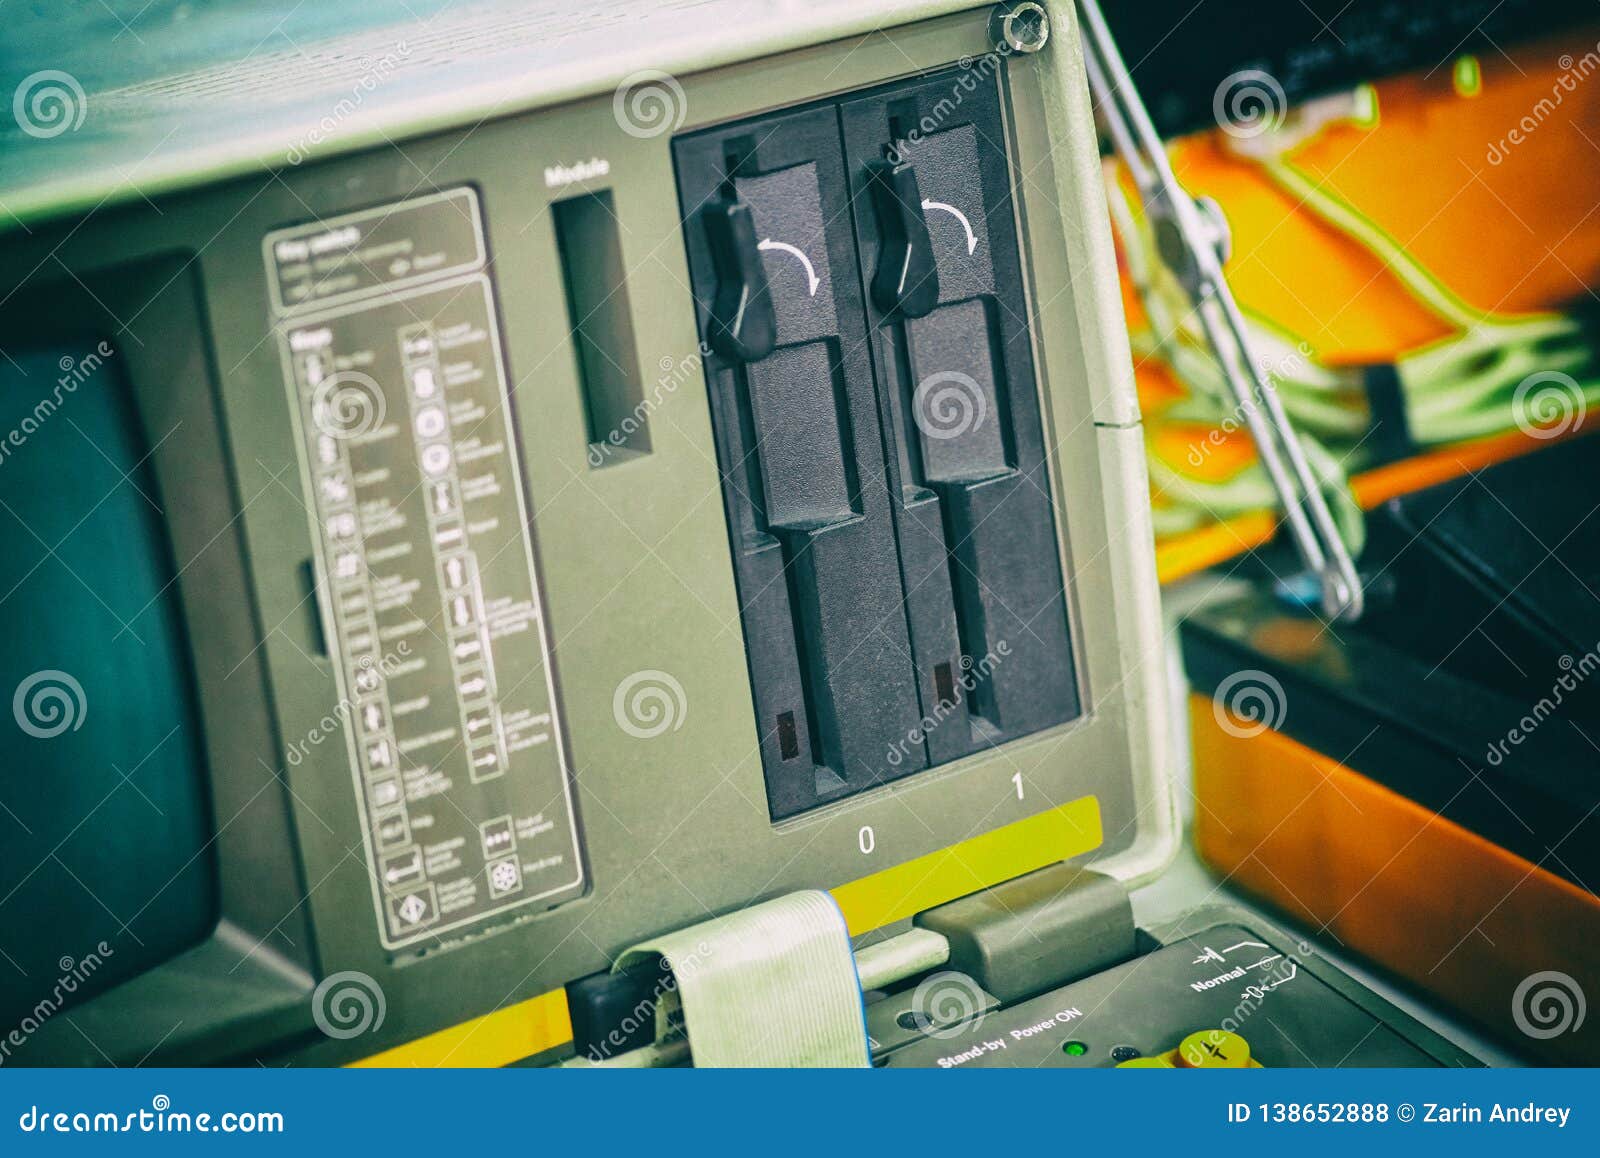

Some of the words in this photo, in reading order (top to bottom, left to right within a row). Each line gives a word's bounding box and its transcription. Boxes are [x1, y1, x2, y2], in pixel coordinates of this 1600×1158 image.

[545, 157, 610, 188] Module
[1012, 773, 1024, 799] 1
[859, 827, 875, 854] 0
[1190, 965, 1248, 992] Normal
[937, 1038, 1006, 1068] Stand-by
[1010, 1016, 1057, 1044] Power
[1054, 1007, 1082, 1027] ON
